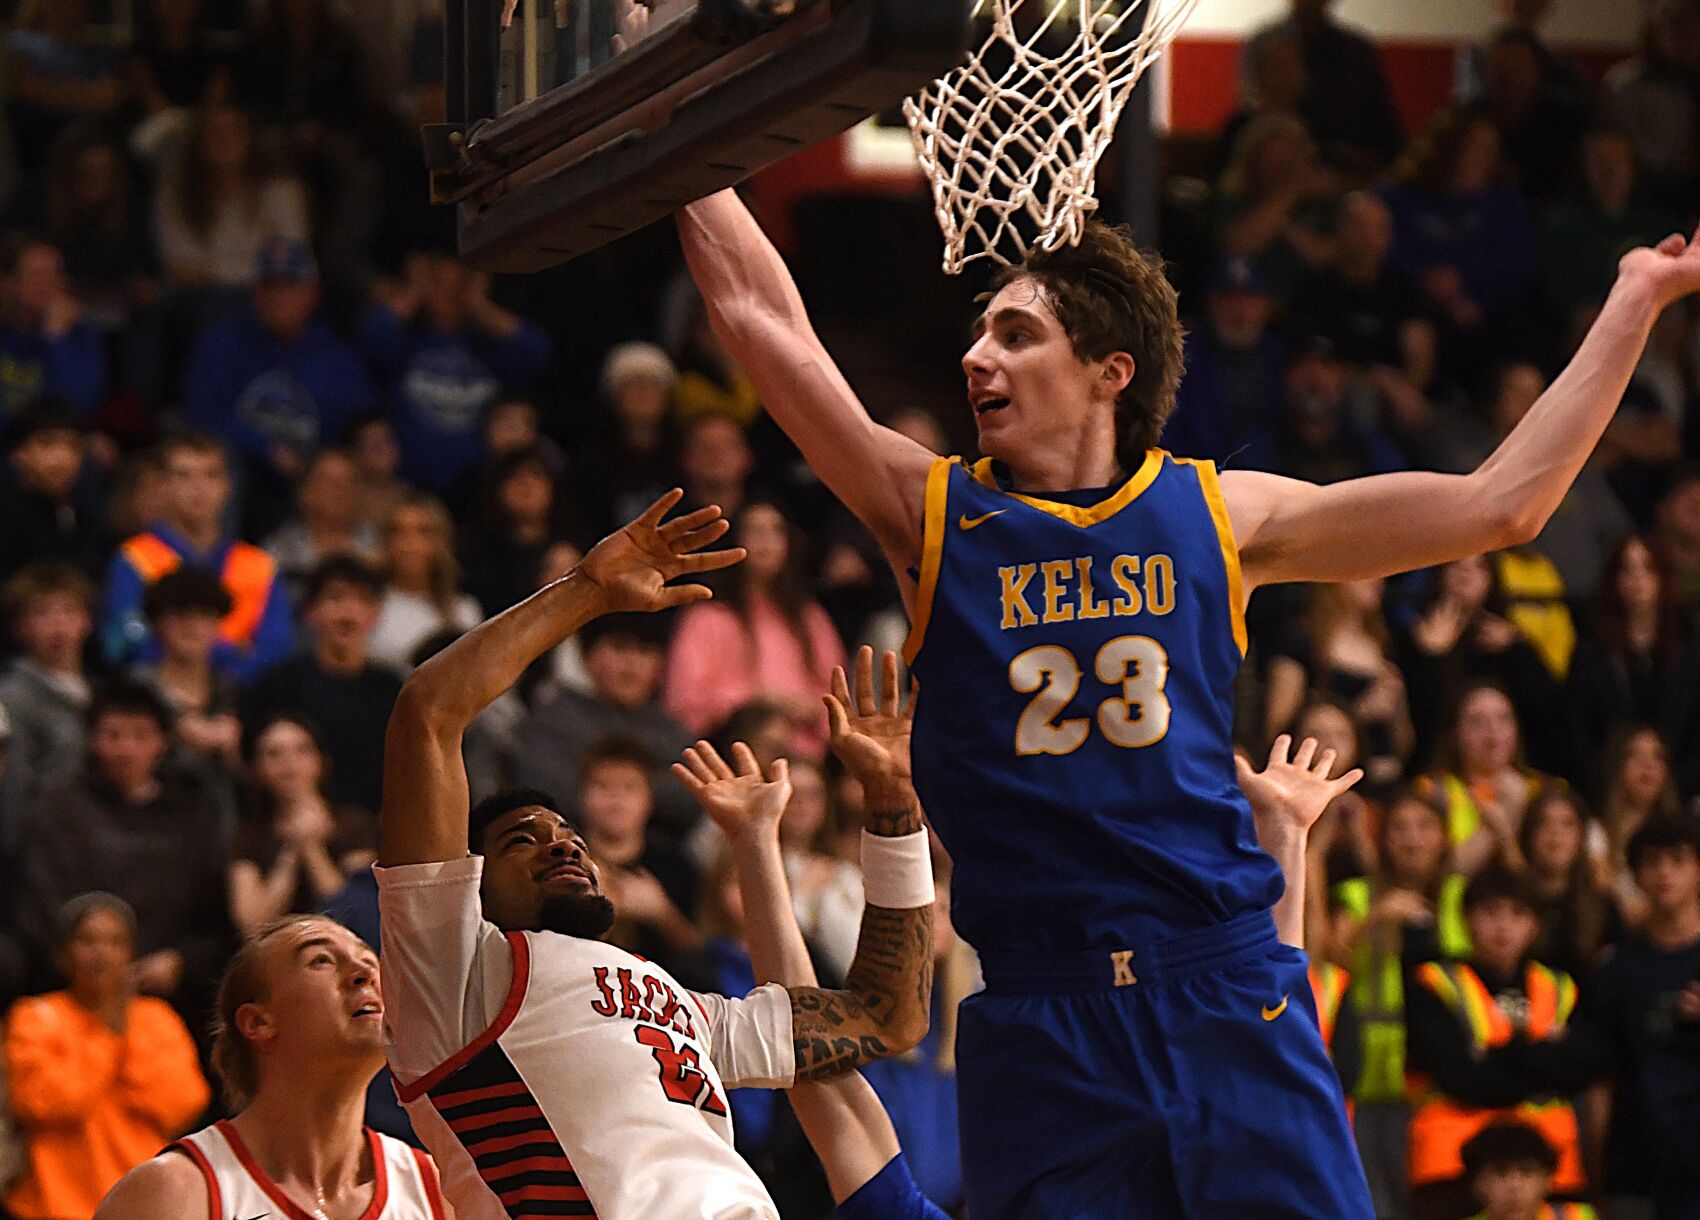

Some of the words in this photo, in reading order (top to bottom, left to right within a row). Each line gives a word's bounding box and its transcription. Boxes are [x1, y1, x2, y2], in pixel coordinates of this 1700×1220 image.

[998, 553, 1178, 630] KELSO
[1009, 634, 1172, 757] 23
[1110, 949, 1138, 987] K
